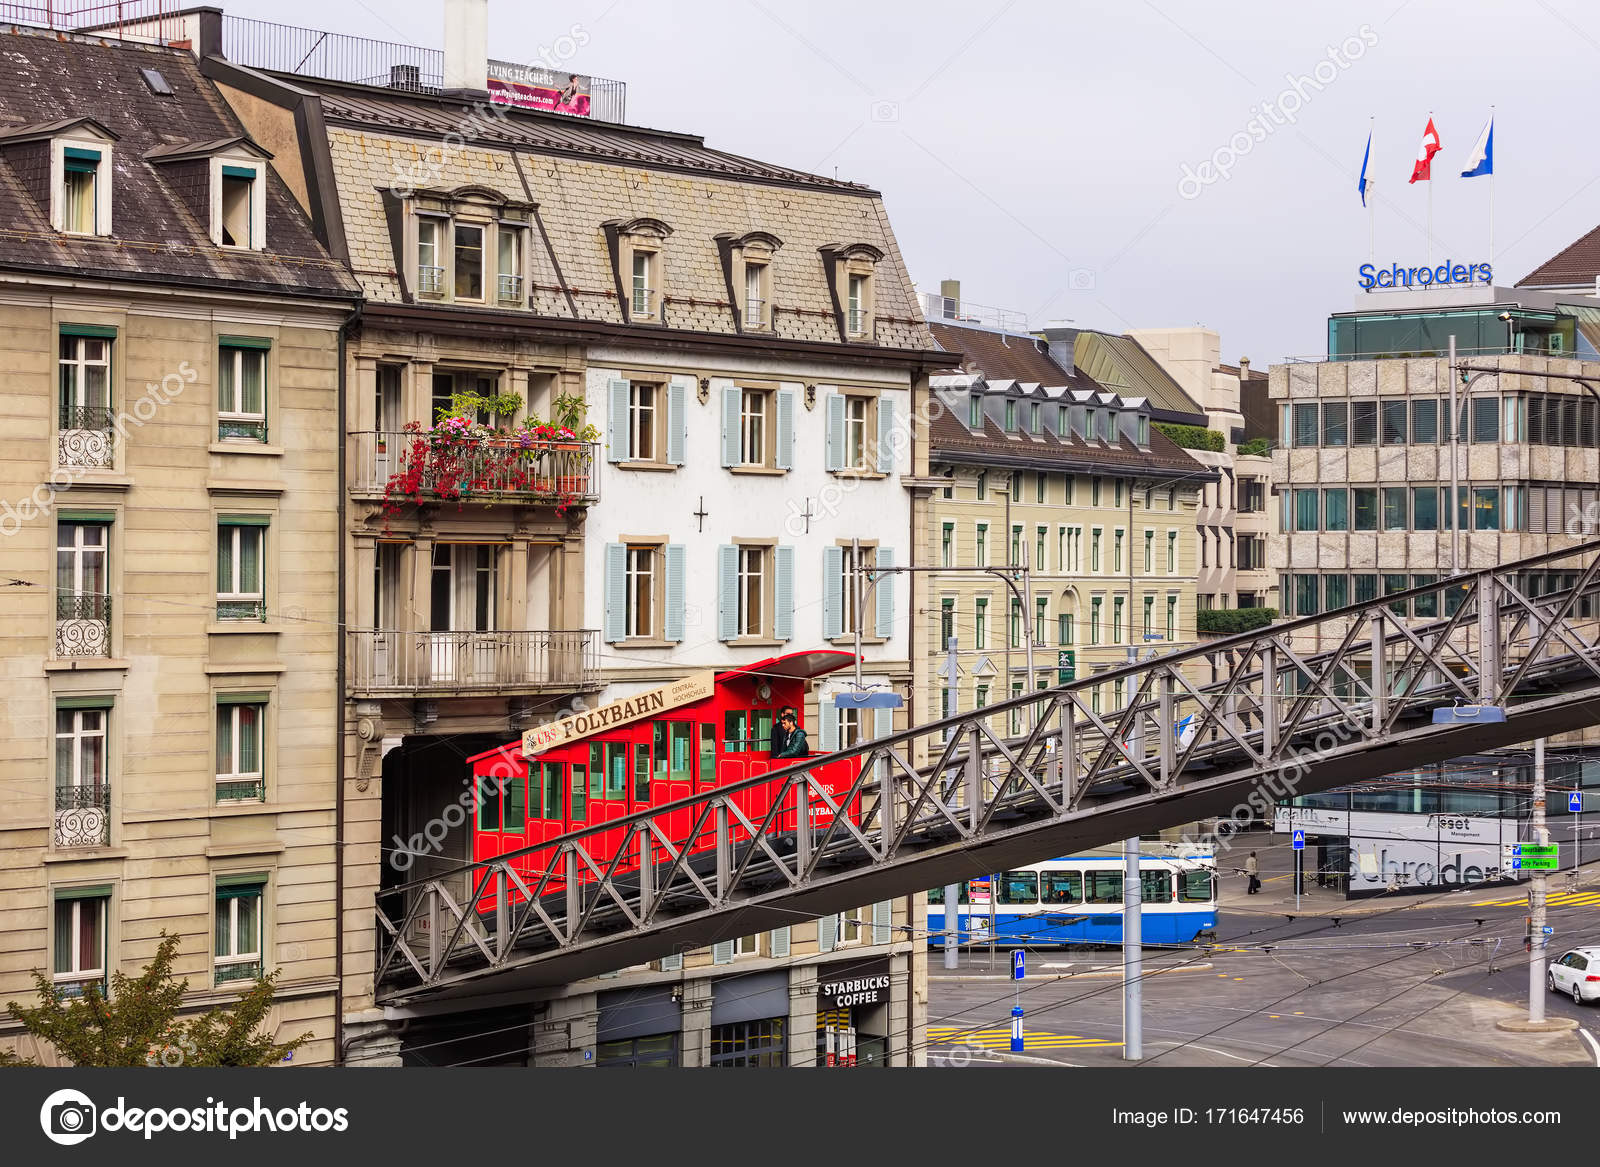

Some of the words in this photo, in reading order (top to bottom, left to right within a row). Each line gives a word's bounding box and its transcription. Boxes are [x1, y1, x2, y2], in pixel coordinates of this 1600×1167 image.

[514, 69, 553, 86] TEACHERS
[1358, 259, 1493, 289] Schroders
[536, 727, 557, 745] UBS
[563, 690, 664, 739] POLYBAHN
[824, 976, 890, 996] STARBUCKS
[837, 991, 878, 1008] COFFEE
